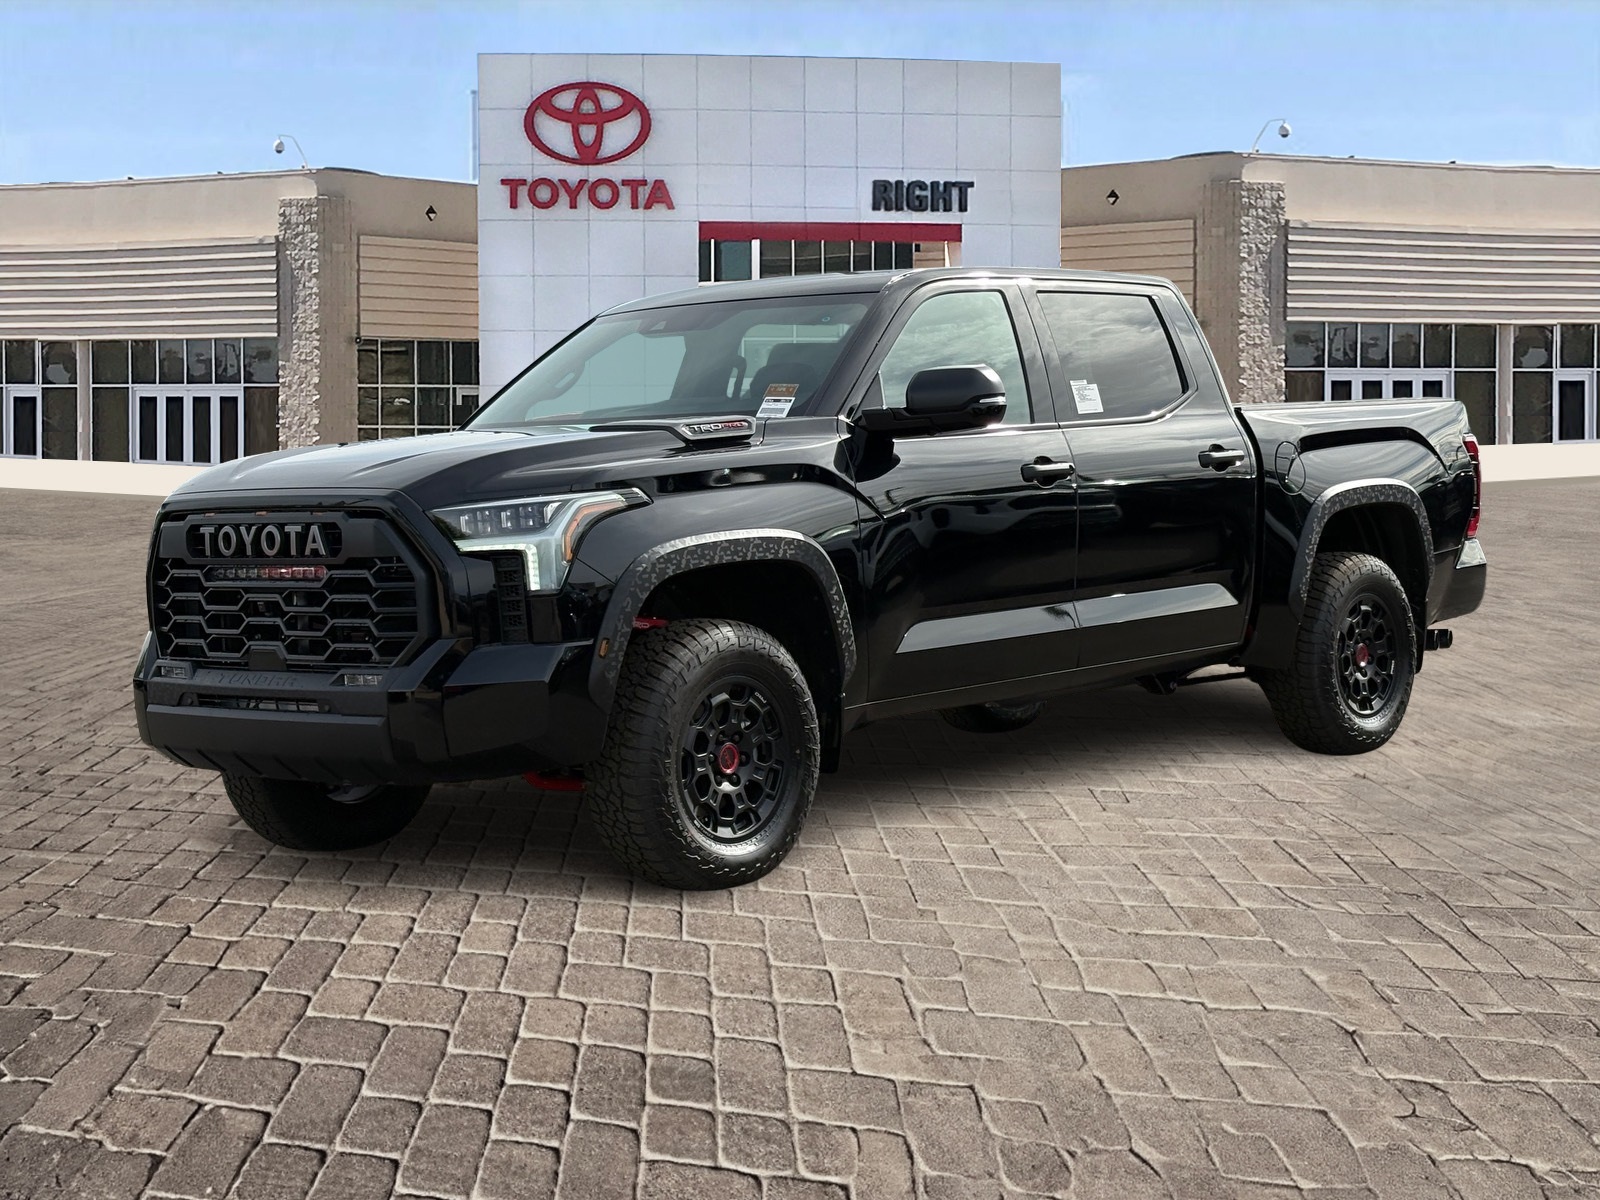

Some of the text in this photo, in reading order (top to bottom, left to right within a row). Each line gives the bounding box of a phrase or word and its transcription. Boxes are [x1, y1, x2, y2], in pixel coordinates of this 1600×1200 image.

[500, 178, 675, 210] TOYOTA
[871, 179, 975, 213] RIGHT
[200, 524, 327, 556] TOYOTA
